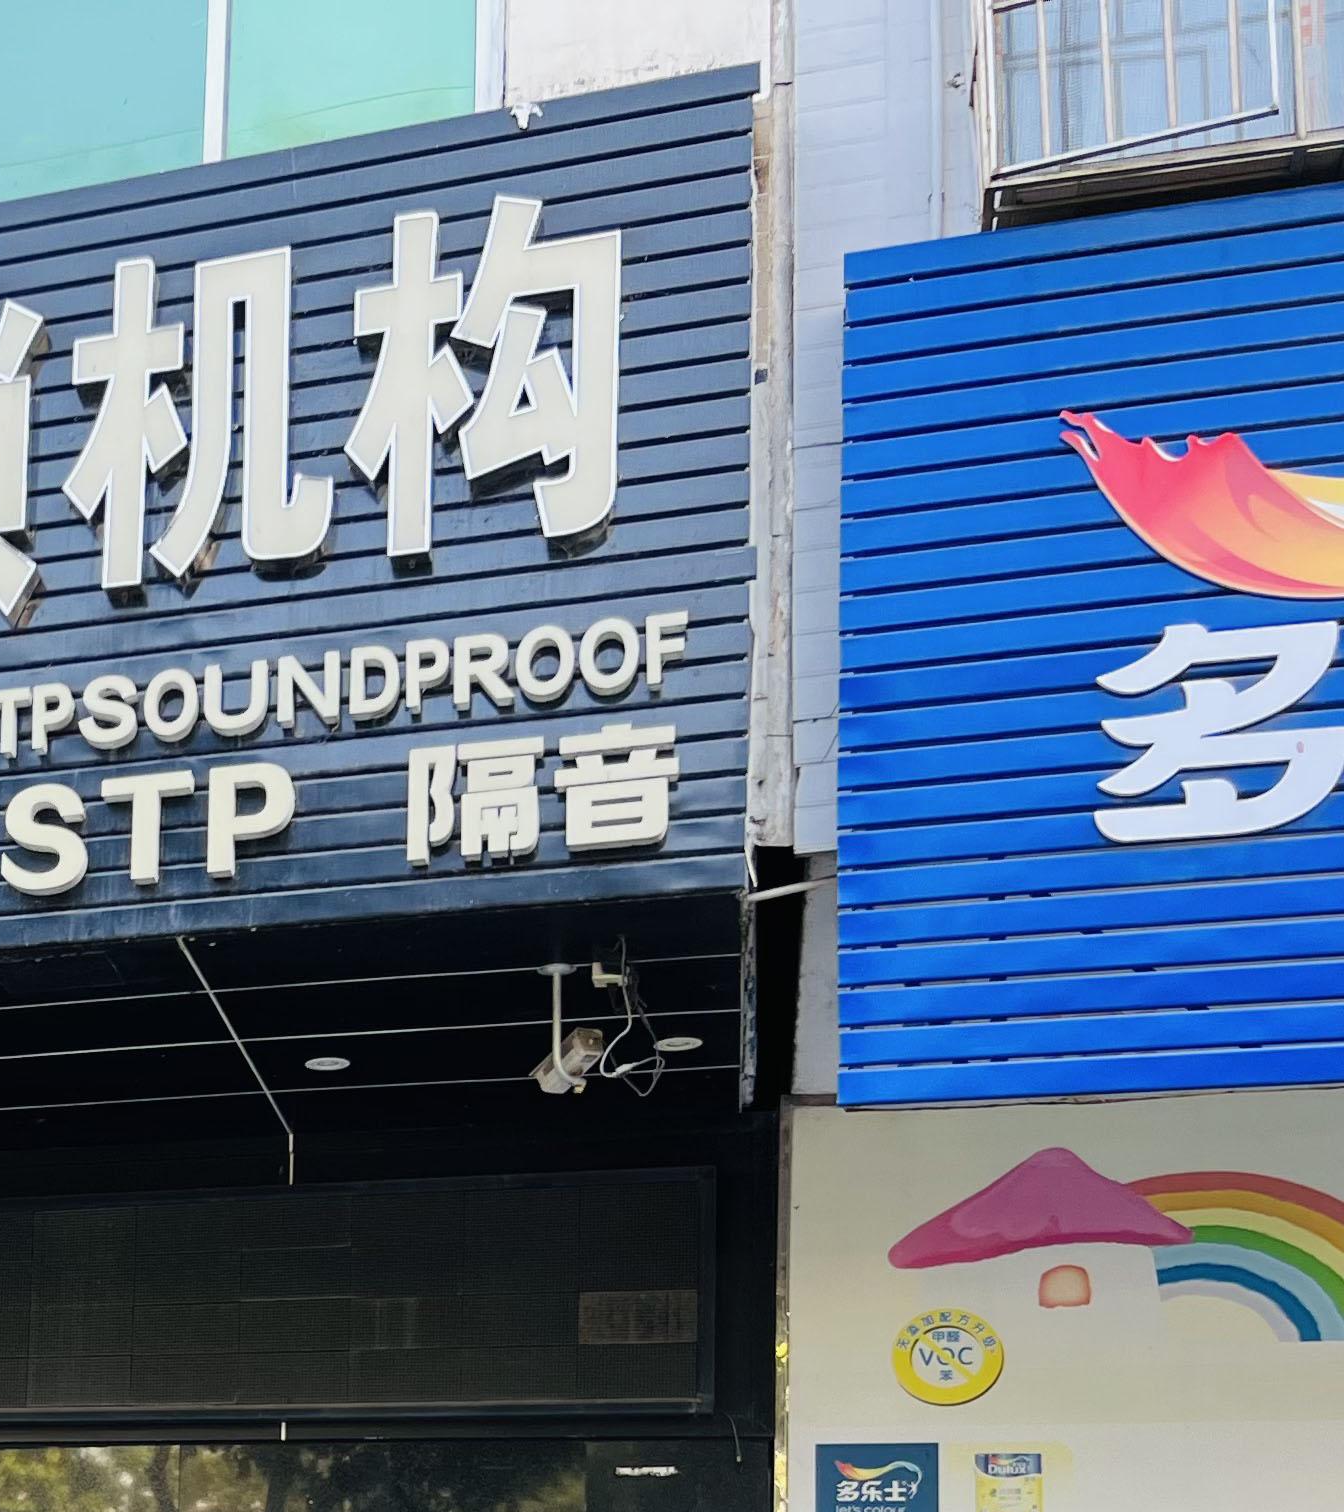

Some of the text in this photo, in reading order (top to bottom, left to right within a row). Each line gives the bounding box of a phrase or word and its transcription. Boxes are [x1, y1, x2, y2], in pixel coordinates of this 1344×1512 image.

[1094, 621, 1344, 844] 多
[0, 762, 296, 897] STP
[405, 723, 681, 868] 隔音
[918, 1346, 974, 1367] VOC
[988, 1464, 1028, 1475] Dulux
[835, 1480, 907, 1503] 多乐士
